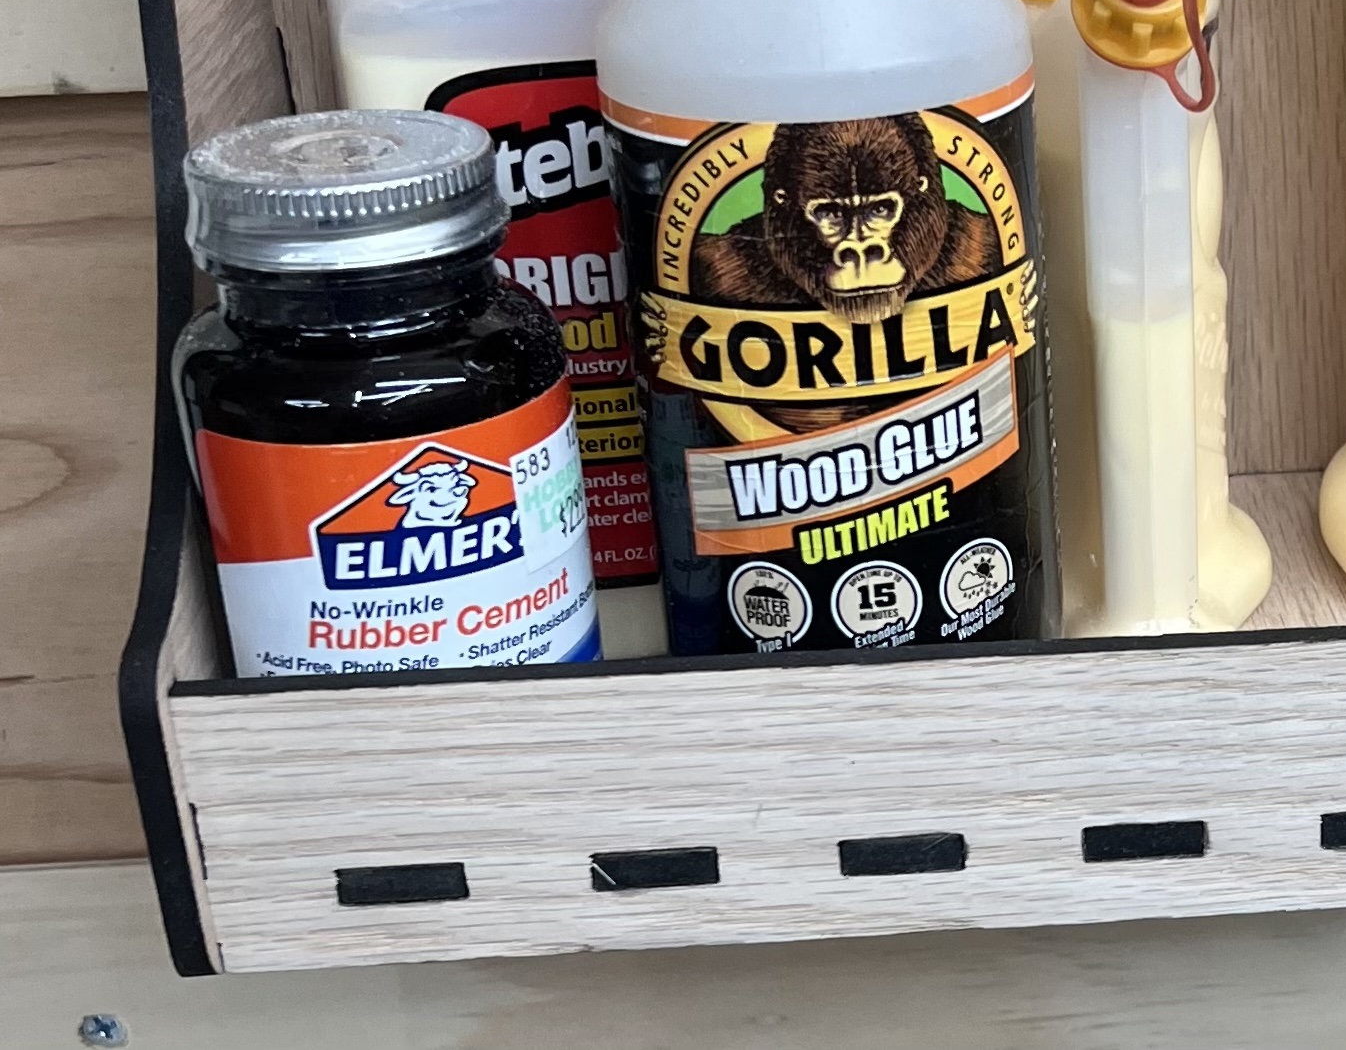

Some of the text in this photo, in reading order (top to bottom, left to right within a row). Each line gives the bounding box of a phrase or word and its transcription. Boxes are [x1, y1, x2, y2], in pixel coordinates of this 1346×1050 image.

[495, 120, 610, 206] teb
[947, 135, 1019, 251] STRONG
[663, 138, 749, 283] INCREDIBLY
[494, 252, 627, 307] RIGI
[563, 312, 617, 351] od
[679, 287, 1018, 389] GORILLA
[575, 392, 636, 416] ional
[578, 433, 643, 454] terior
[516, 447, 550, 485] 583
[583, 471, 628, 489] ands
[604, 491, 649, 507] clam
[799, 485, 951, 566] ULTIMATE
[335, 508, 525, 580] ELMER'
[308, 567, 569, 650] Rubber Cement
[310, 595, 444, 620] No-Wrinkle
[744, 594, 791, 615] WATER
[857, 582, 897, 610] 15
[747, 610, 792, 628] PROOF
[859, 608, 899, 621] MINUTES
[960, 605, 983, 627] Most
[467, 631, 527, 660] Shatter
[529, 598, 579, 641] Resistant
[854, 619, 904, 648] Extended
[262, 651, 294, 670] Acid
[341, 660, 394, 675] Photo
[397, 654, 440, 672] Safe
[516, 640, 553, 666] Clear
